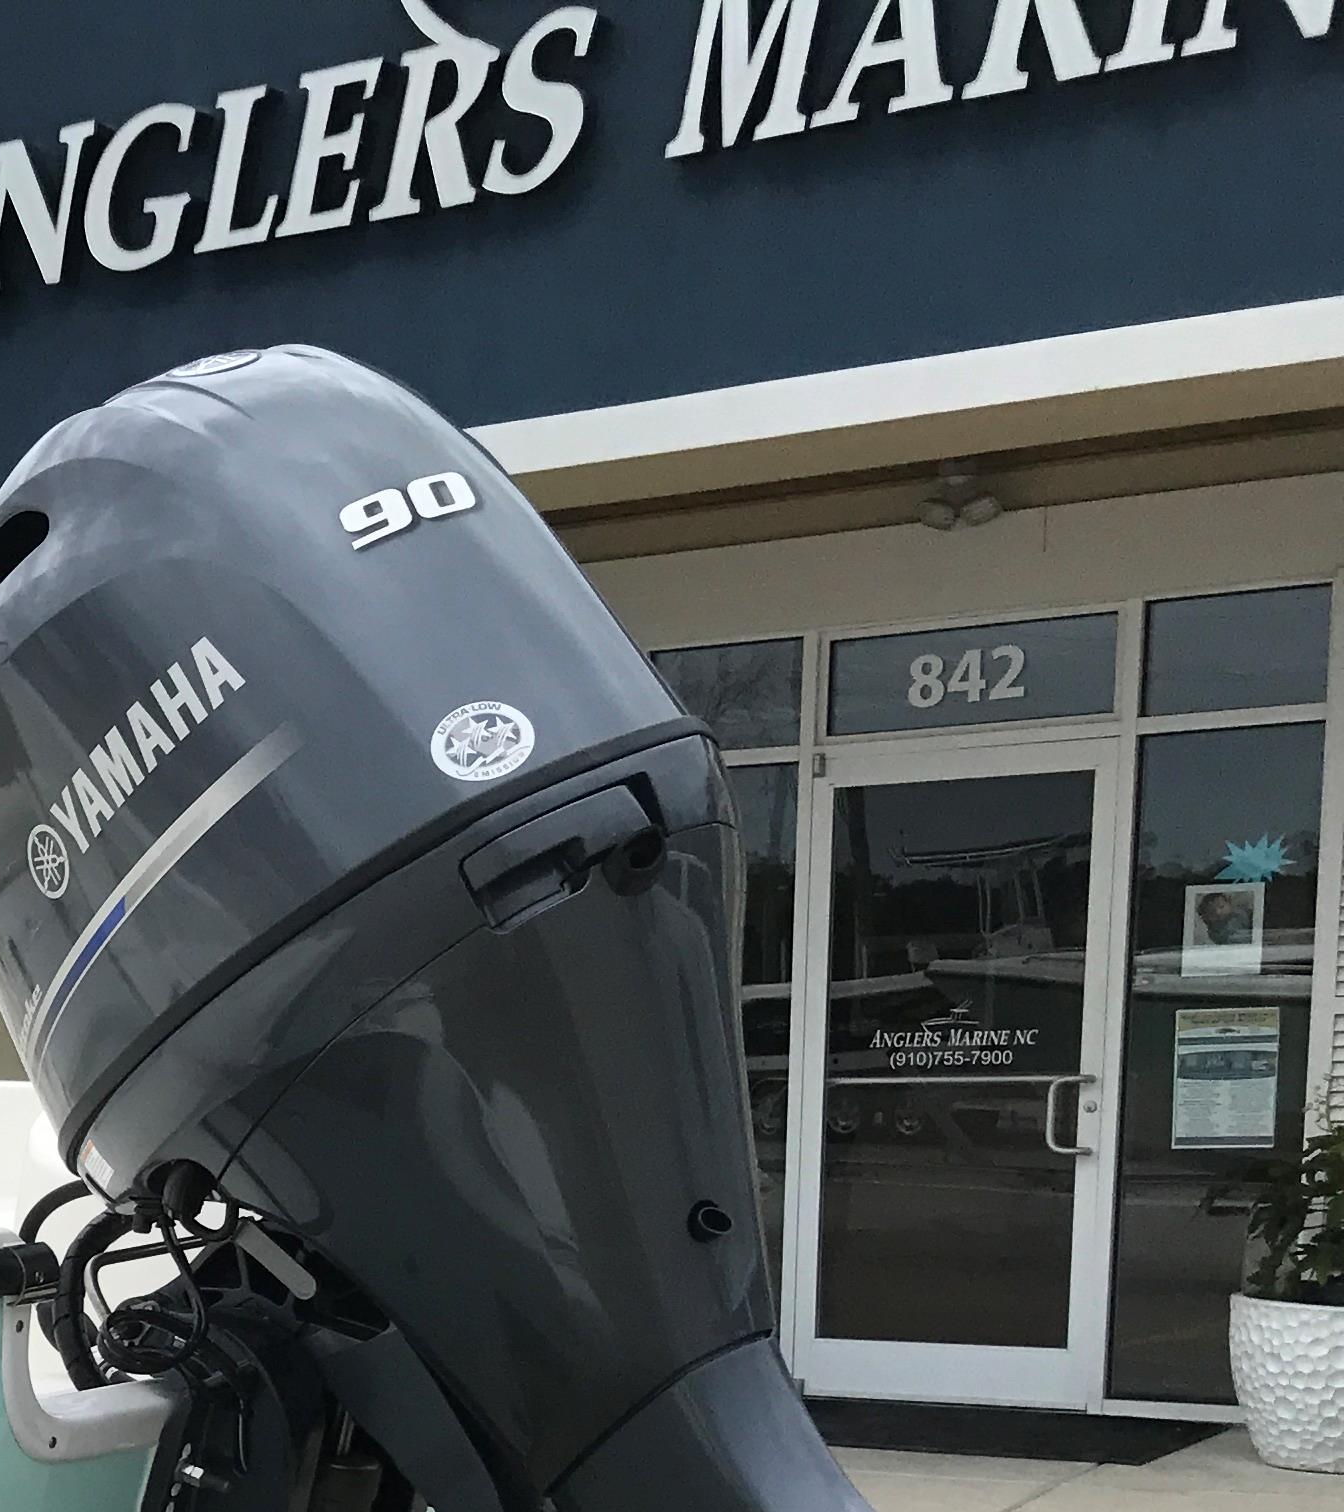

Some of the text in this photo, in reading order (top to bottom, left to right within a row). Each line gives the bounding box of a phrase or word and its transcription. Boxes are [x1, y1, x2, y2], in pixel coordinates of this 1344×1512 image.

[339, 471, 476, 551] 90
[907, 644, 1025, 708] 842
[49, 636, 246, 854] YAMAHA
[869, 1028, 1039, 1048] ANGLERS MARINE NC
[889, 1050, 1013, 1069] (910)755-7900
